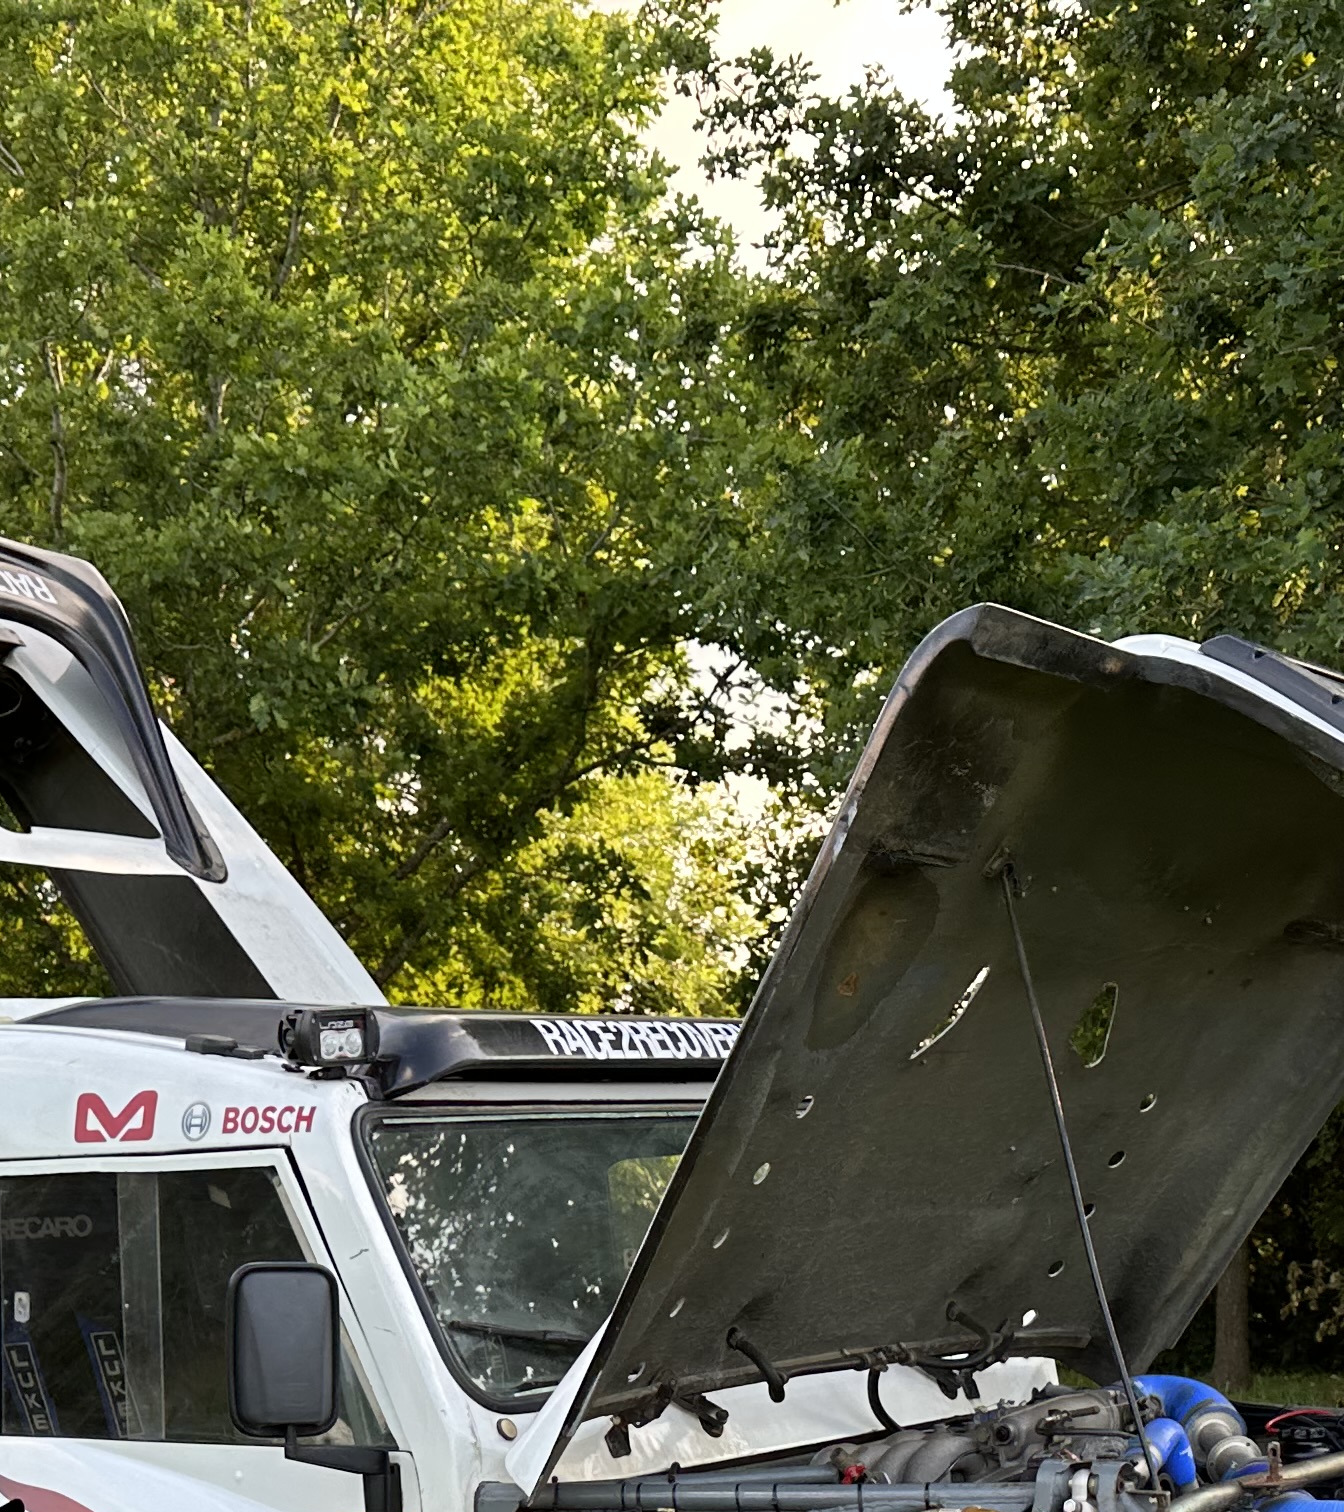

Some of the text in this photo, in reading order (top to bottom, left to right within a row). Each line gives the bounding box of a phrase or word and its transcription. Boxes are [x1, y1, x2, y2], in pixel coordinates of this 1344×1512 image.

[529, 1019, 742, 1059] RACE2RECOVER
[222, 1106, 317, 1134] BOSCH
[9, 1350, 50, 1431] LUKE
[96, 1338, 134, 1418] LUKE
